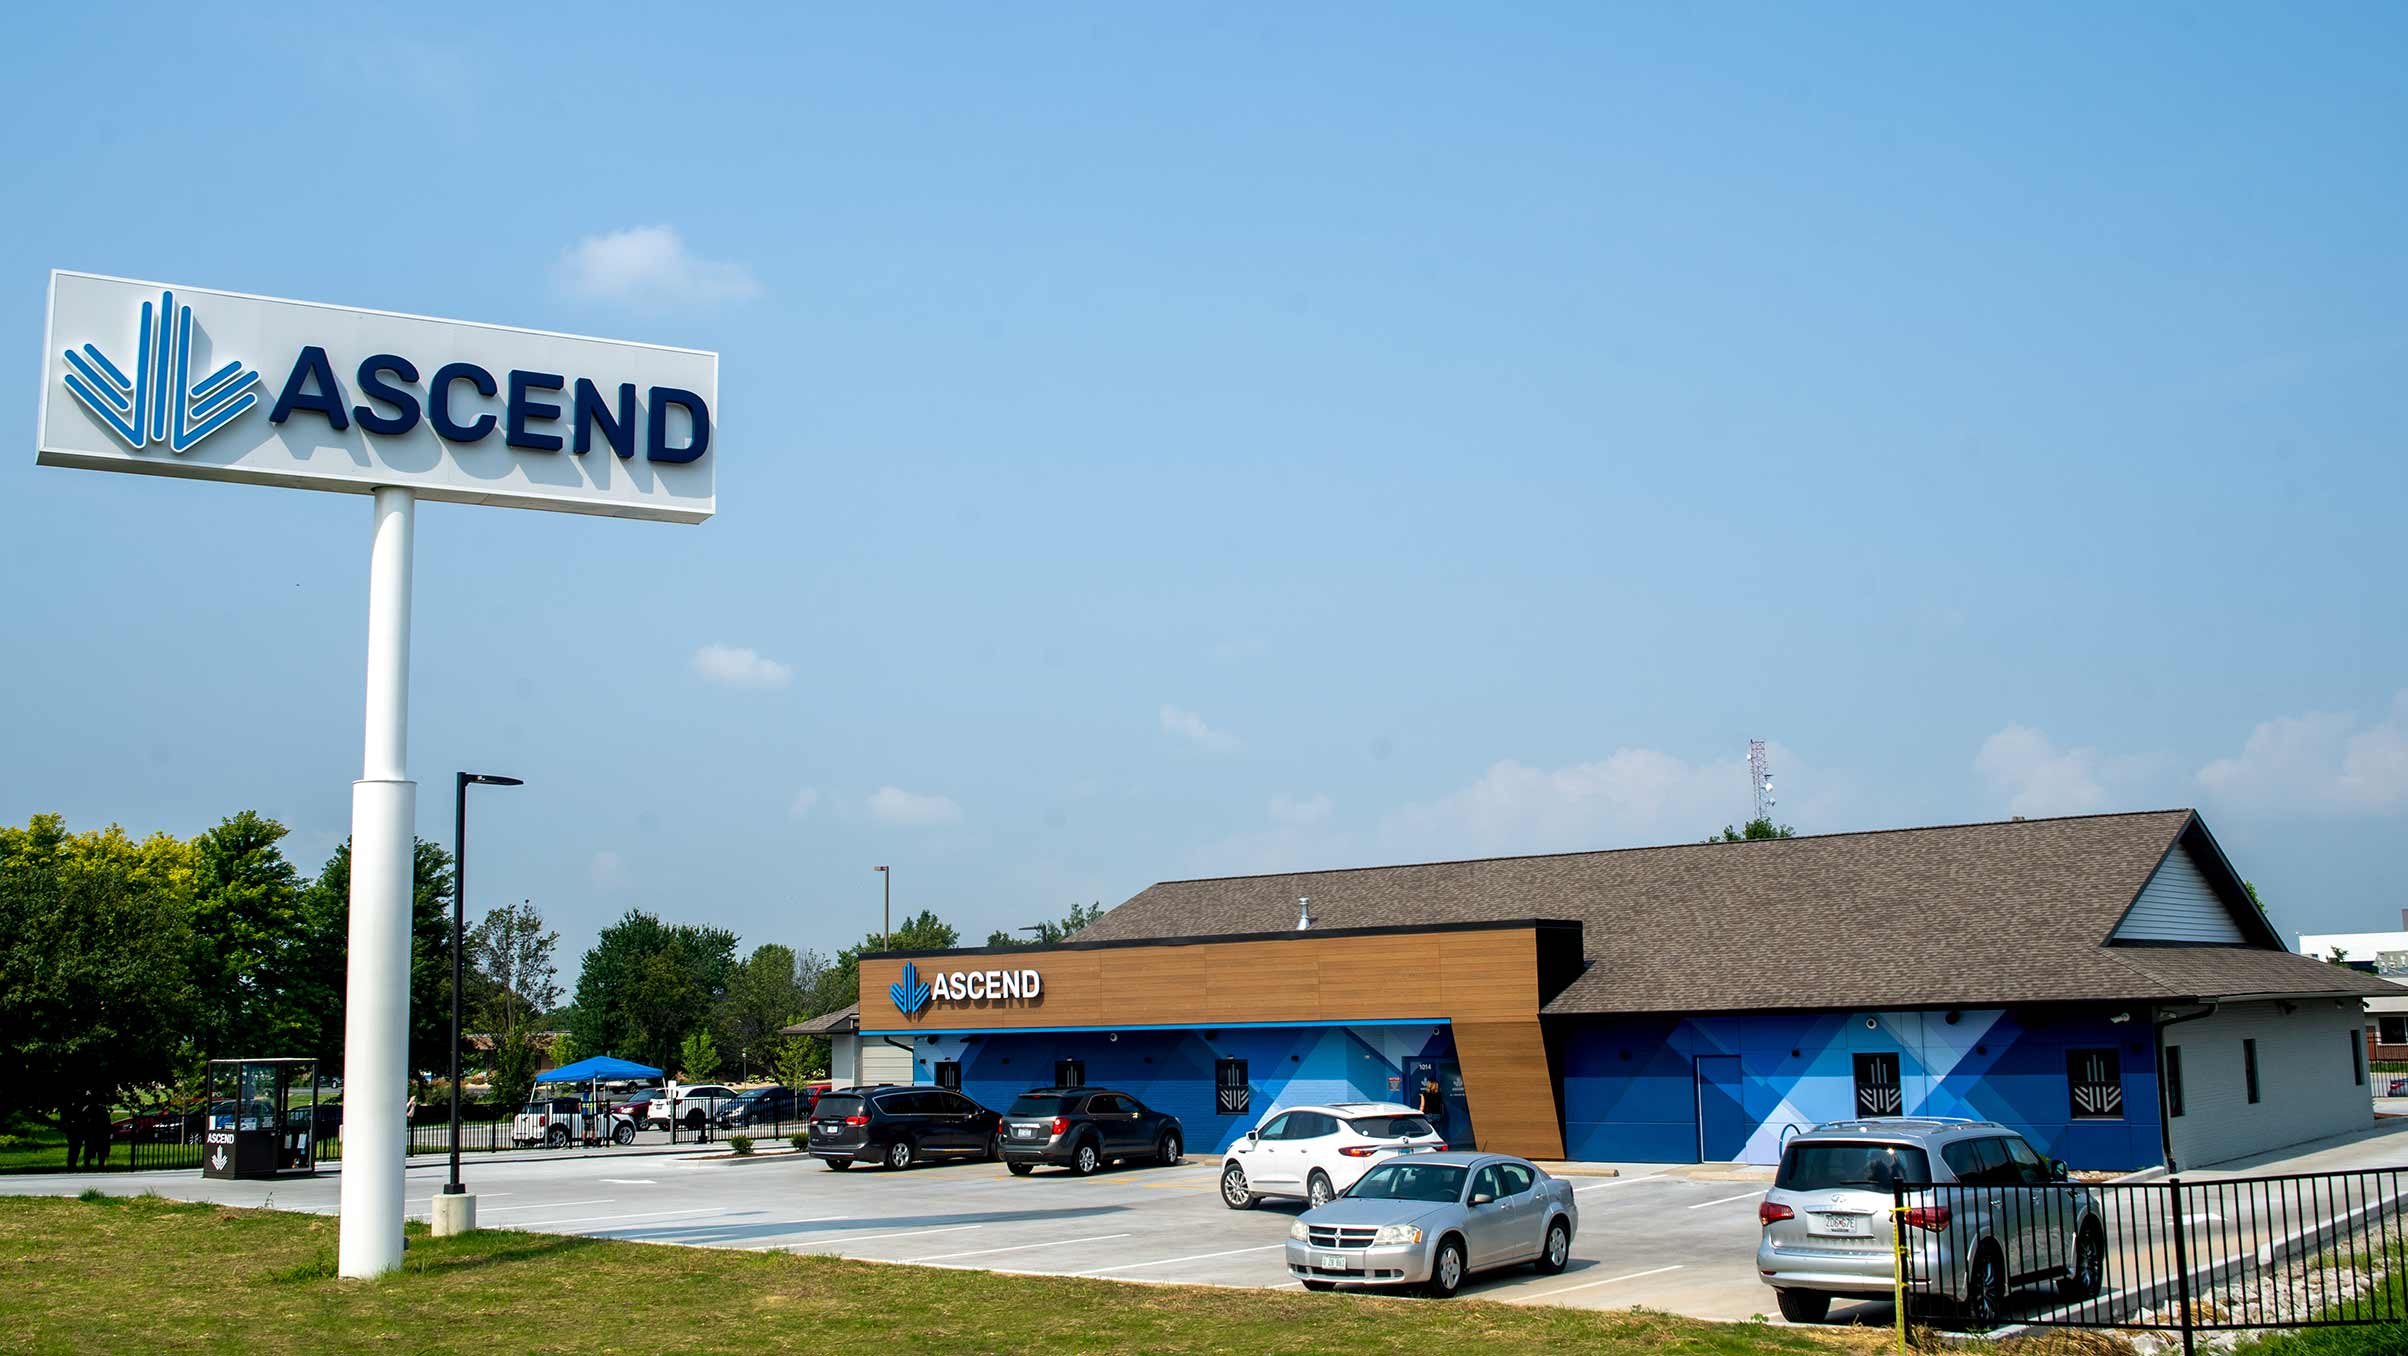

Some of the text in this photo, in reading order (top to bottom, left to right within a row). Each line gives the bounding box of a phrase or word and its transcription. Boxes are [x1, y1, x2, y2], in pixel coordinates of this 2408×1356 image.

[269, 345, 710, 463] ASCEND
[931, 969, 1040, 1000] ASCEND
[207, 1133, 235, 1144] ASCEND
